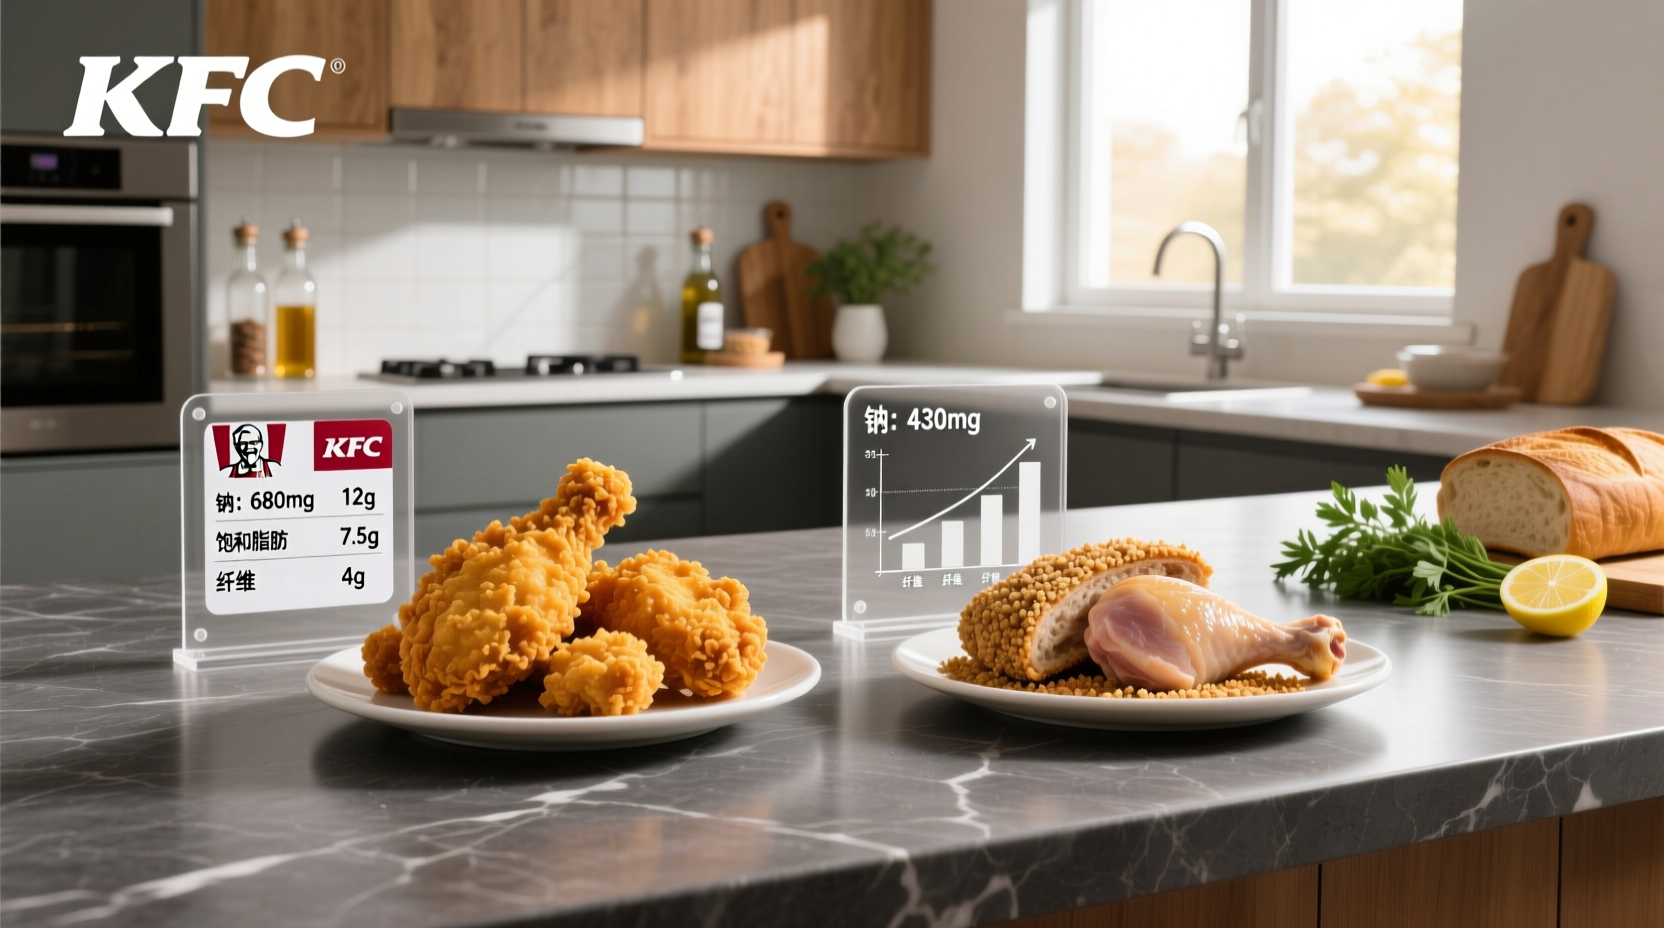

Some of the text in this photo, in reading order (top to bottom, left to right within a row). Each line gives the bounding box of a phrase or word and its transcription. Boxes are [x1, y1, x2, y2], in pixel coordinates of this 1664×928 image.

[322, 436, 383, 459] KFC
[342, 487, 376, 510] 12g
[215, 526, 379, 553] 饱和脂肪 7.5g
[215, 567, 365, 593] 纤维 4g
